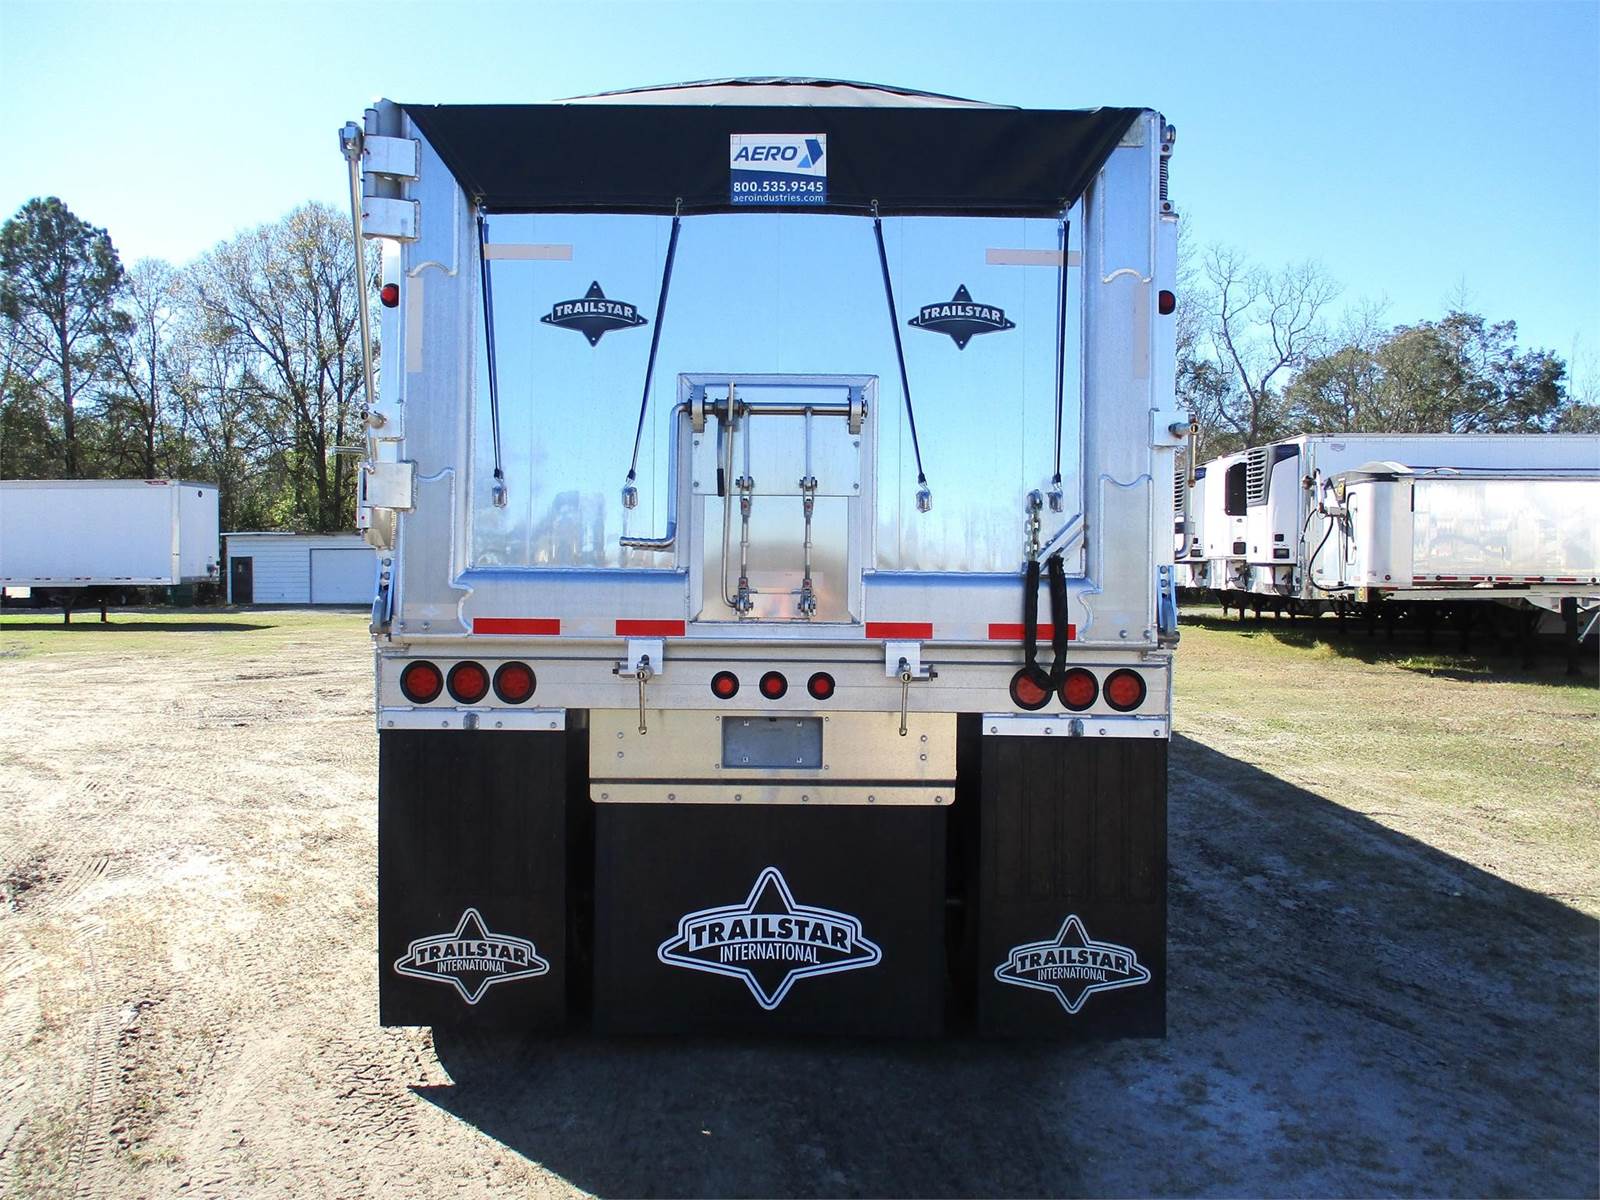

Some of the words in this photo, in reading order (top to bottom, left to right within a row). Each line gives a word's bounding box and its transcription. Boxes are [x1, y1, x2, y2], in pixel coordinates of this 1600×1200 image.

[733, 146, 798, 162] AERO
[733, 181, 824, 193] 800.535.9545
[733, 193, 824, 202] aeroindustries.com
[555, 302, 633, 318] TRAILSTAR
[922, 305, 1001, 321] TRAILSTAR
[691, 917, 849, 950] TRAILSTAR
[417, 942, 527, 964] TRAILSTAR
[720, 942, 821, 964] INTERNATIONAL
[1018, 949, 1128, 972] TRAILSTAR
[437, 958, 507, 974] INTERNATIONAL
[1037, 966, 1108, 982] INTERNATIONAL
